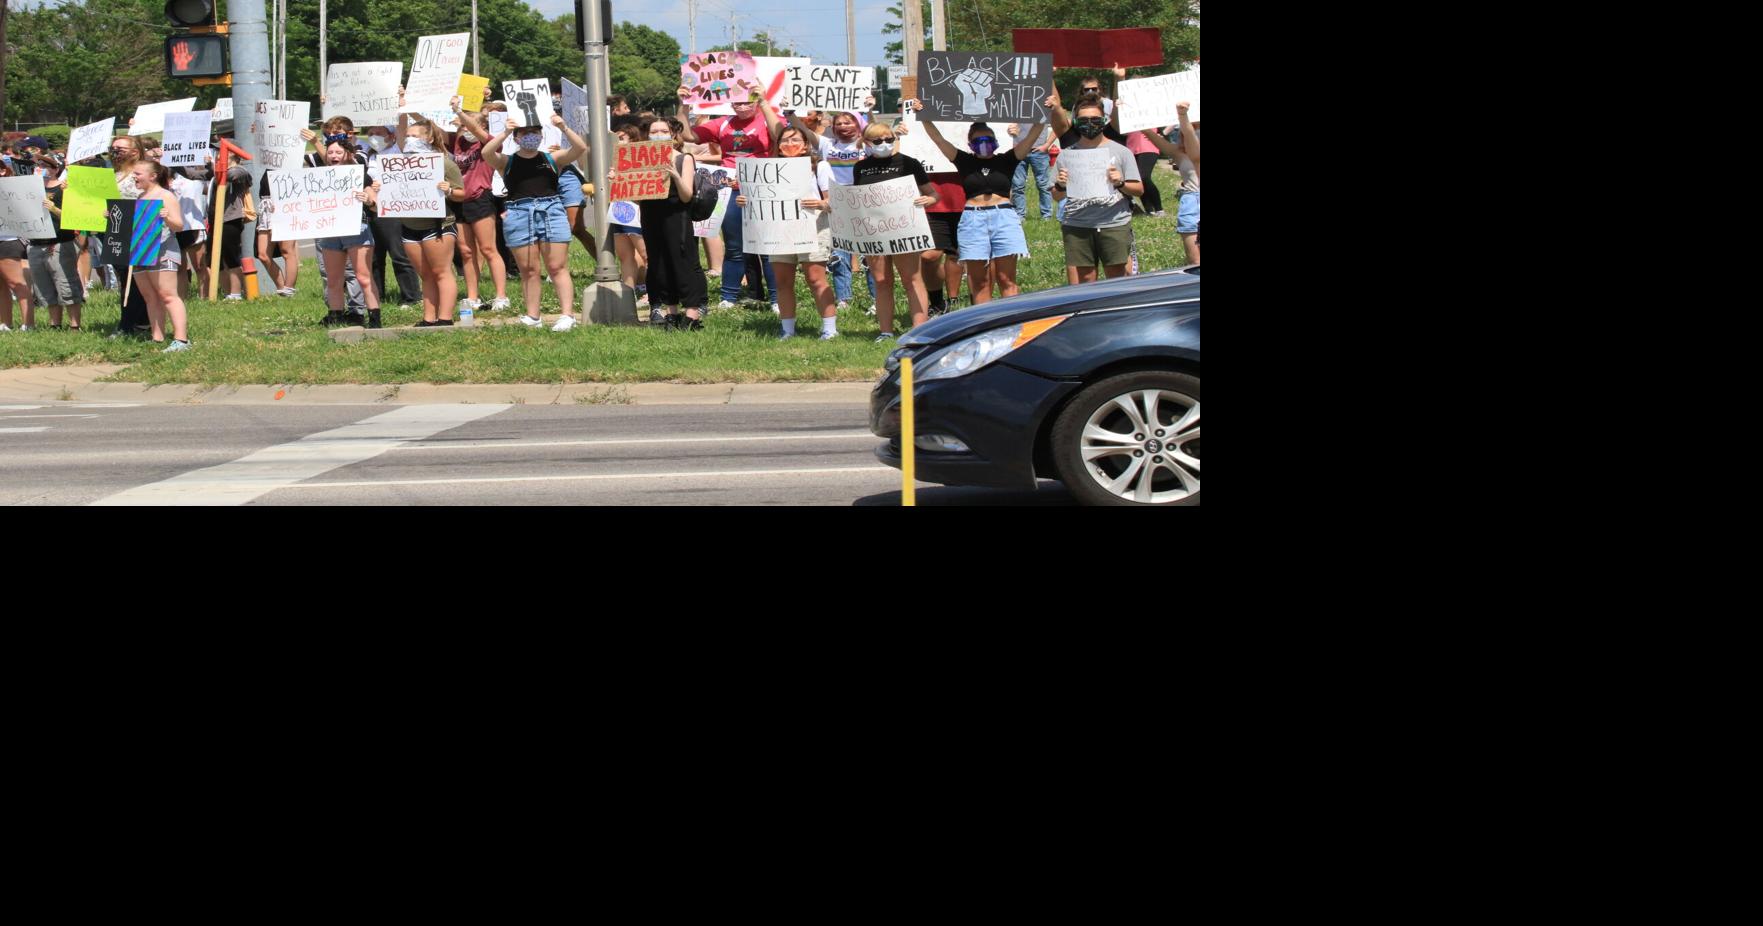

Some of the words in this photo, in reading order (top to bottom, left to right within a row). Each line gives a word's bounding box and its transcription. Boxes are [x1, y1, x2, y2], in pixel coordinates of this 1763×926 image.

[413, 39, 444, 72] LOVE
[700, 68, 735, 83] LIVES
[811, 67, 861, 84] CAN'T
[921, 88, 965, 121] LIVES
[989, 83, 1047, 120] MATTER
[164, 143, 182, 152] BLACK
[188, 141, 207, 150] LIVES
[171, 153, 195, 163] MATTER
[381, 155, 441, 172] RESPECT
[617, 145, 672, 172] BLACK
[738, 162, 791, 185] BLACK
[609, 178, 667, 203] MATTER
[282, 202, 302, 213] are
[307, 192, 337, 210] tired
[316, 215, 337, 230] shit
[857, 240, 884, 254] LIVES
[890, 234, 932, 254] MATTER
